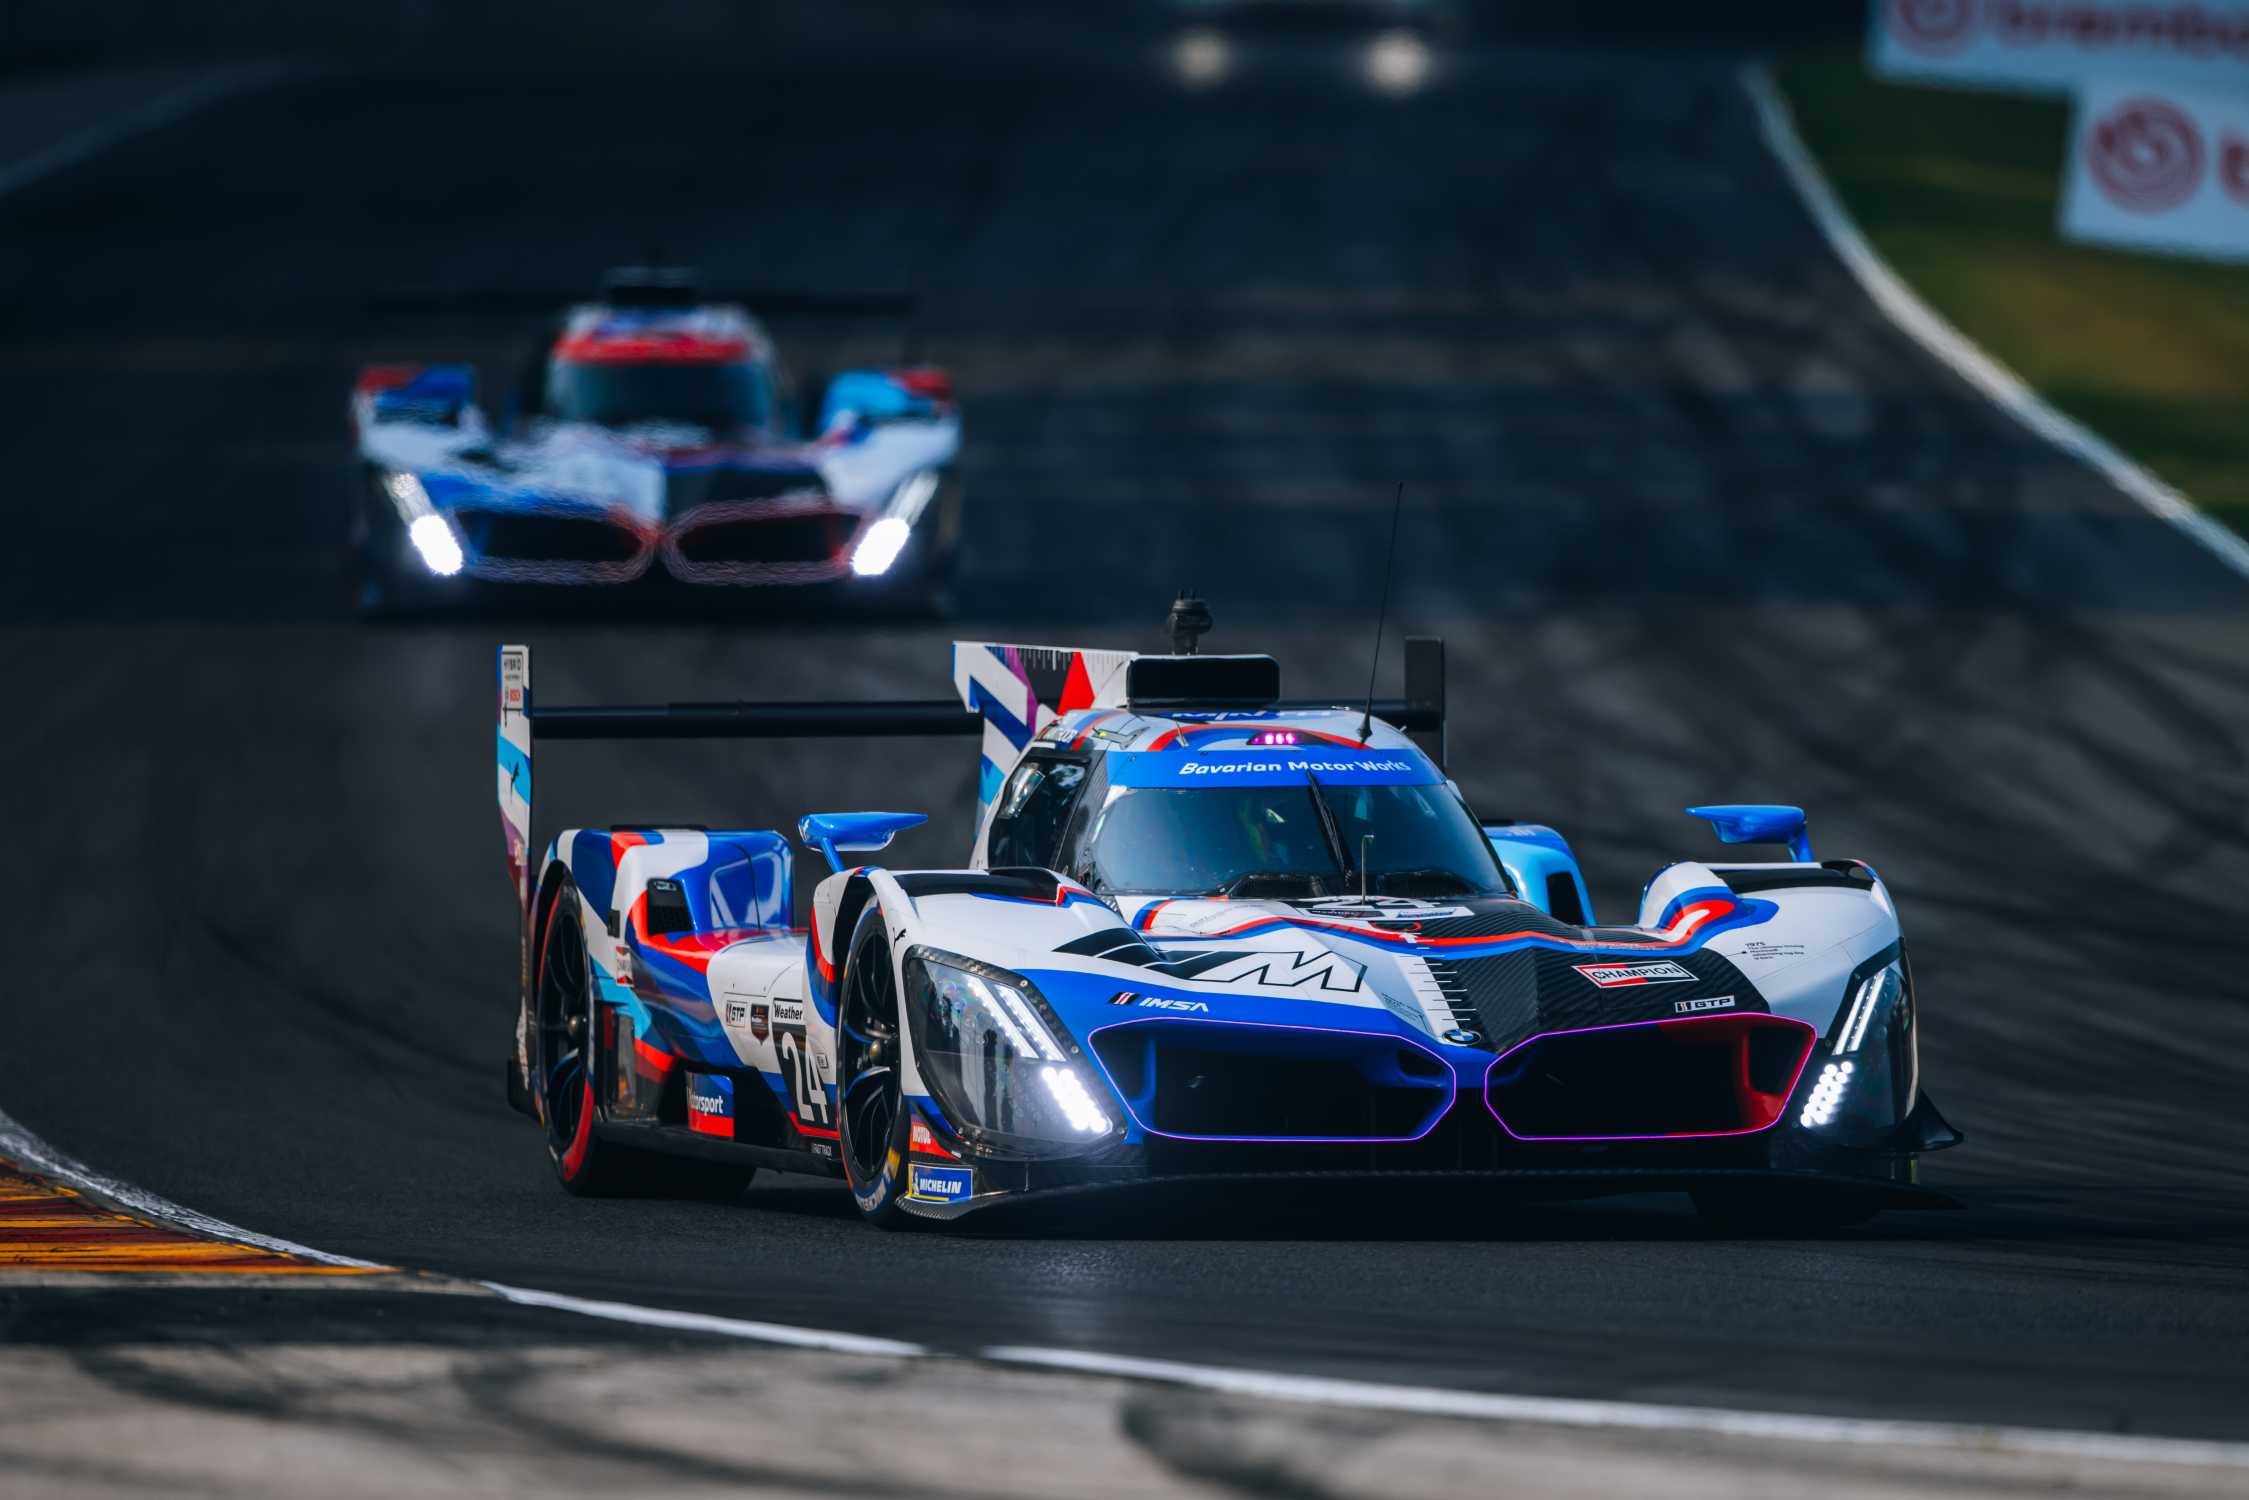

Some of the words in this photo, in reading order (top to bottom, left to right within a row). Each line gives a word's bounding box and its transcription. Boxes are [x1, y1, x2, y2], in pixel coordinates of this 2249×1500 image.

[1179, 762, 1281, 775] Bavarian
[1288, 761, 1354, 772] Motor
[1354, 760, 1411, 772] Works
[1592, 966, 1681, 980] CHAMPION
[1139, 997, 1209, 1013] IMSA
[1694, 997, 1731, 1008] GTP
[774, 1003, 802, 1020] Weather
[781, 1031, 829, 1124] 24
[919, 1179, 962, 1194] MICHELIN
